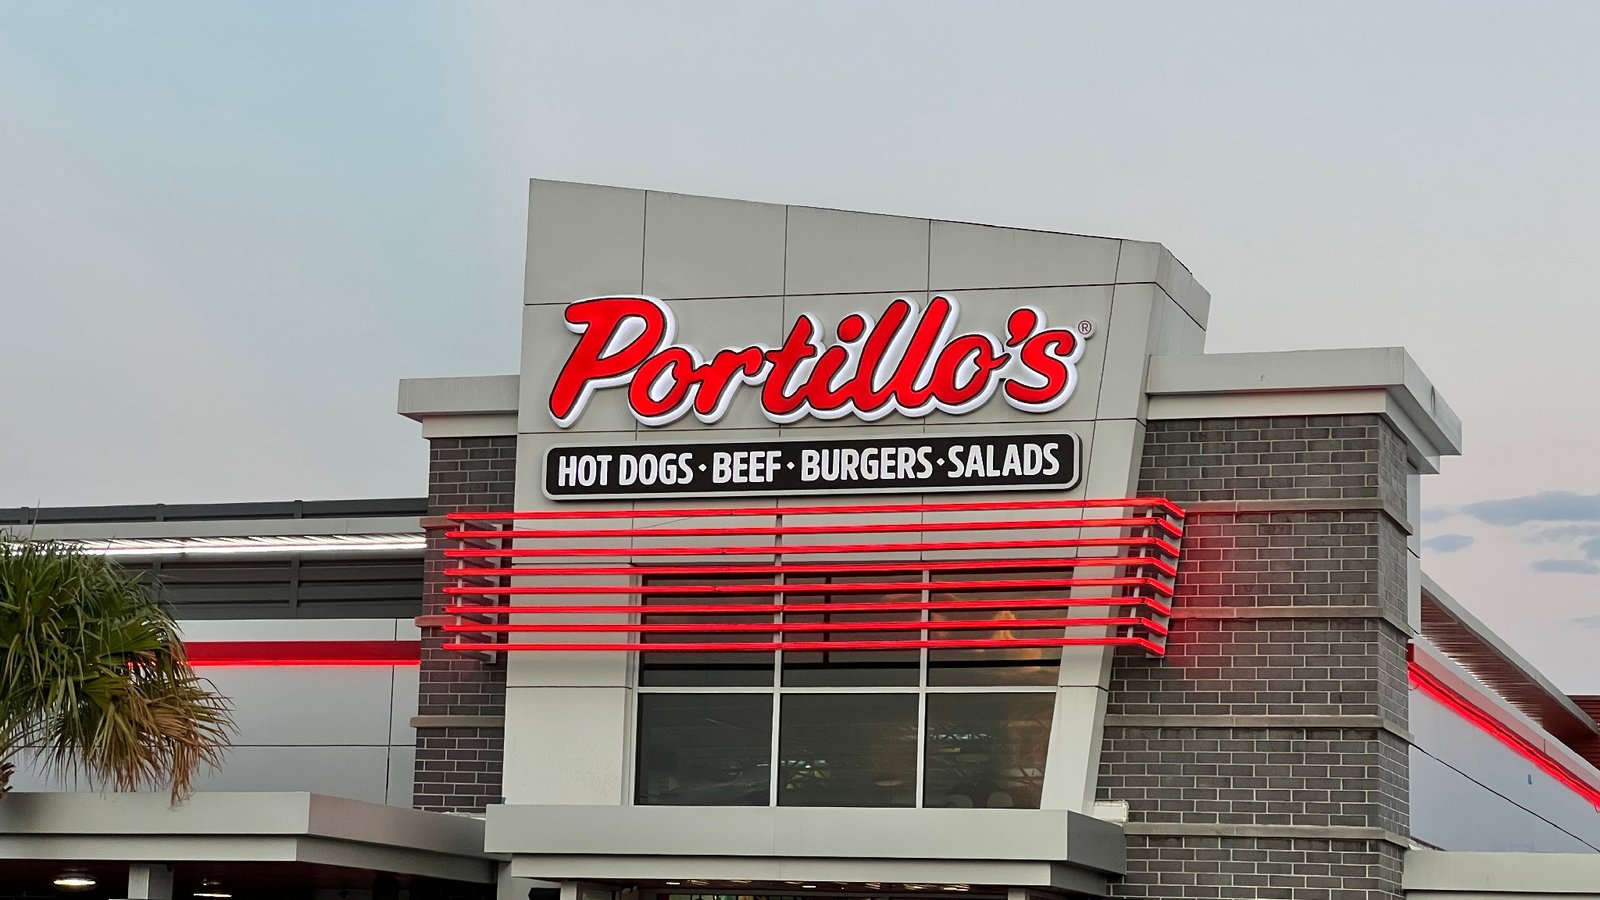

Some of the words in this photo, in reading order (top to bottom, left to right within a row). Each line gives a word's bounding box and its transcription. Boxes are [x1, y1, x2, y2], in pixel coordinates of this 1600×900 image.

[549, 295, 1080, 424] Portillo's
[558, 454, 612, 486] HOT
[618, 453, 694, 486] DOGS
[712, 450, 782, 483] BEEF
[801, 446, 933, 481] BURGERS
[948, 443, 1060, 477] SALADS
